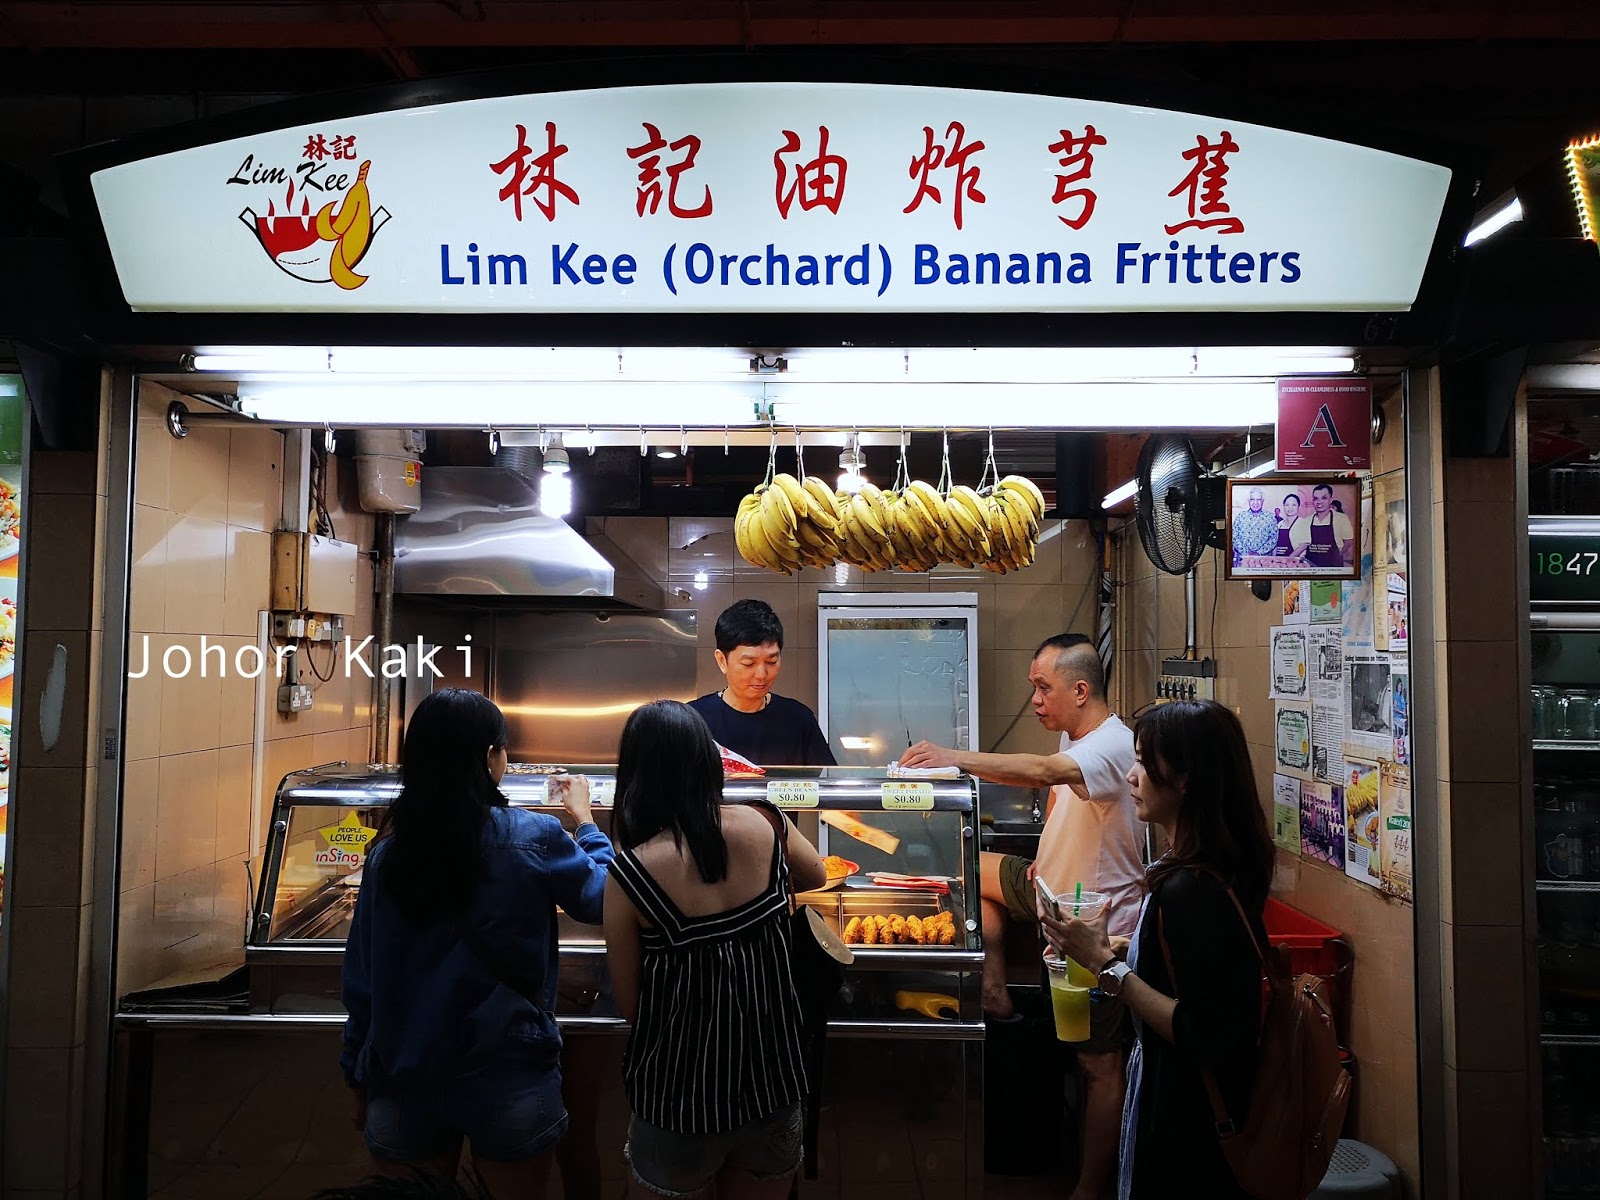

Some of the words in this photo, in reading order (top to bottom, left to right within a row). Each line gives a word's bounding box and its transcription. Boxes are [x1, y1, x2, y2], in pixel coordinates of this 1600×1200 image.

[302, 134, 357, 161] 林記
[226, 154, 288, 185] Lim
[296, 161, 350, 192] Kee
[441, 243, 527, 285] Lim
[552, 243, 637, 285] Kee
[664, 243, 891, 296] (Orchard)
[914, 244, 1091, 285] Banana
[1117, 241, 1301, 284] Fritters
[1300, 403, 1347, 447] A
[1537, 553, 1598, 575] 1847
[779, 793, 805, 801] $0.80
[894, 795, 921, 804] $0.80
[330, 834, 353, 842] LOVE
[355, 834, 368, 842] US
